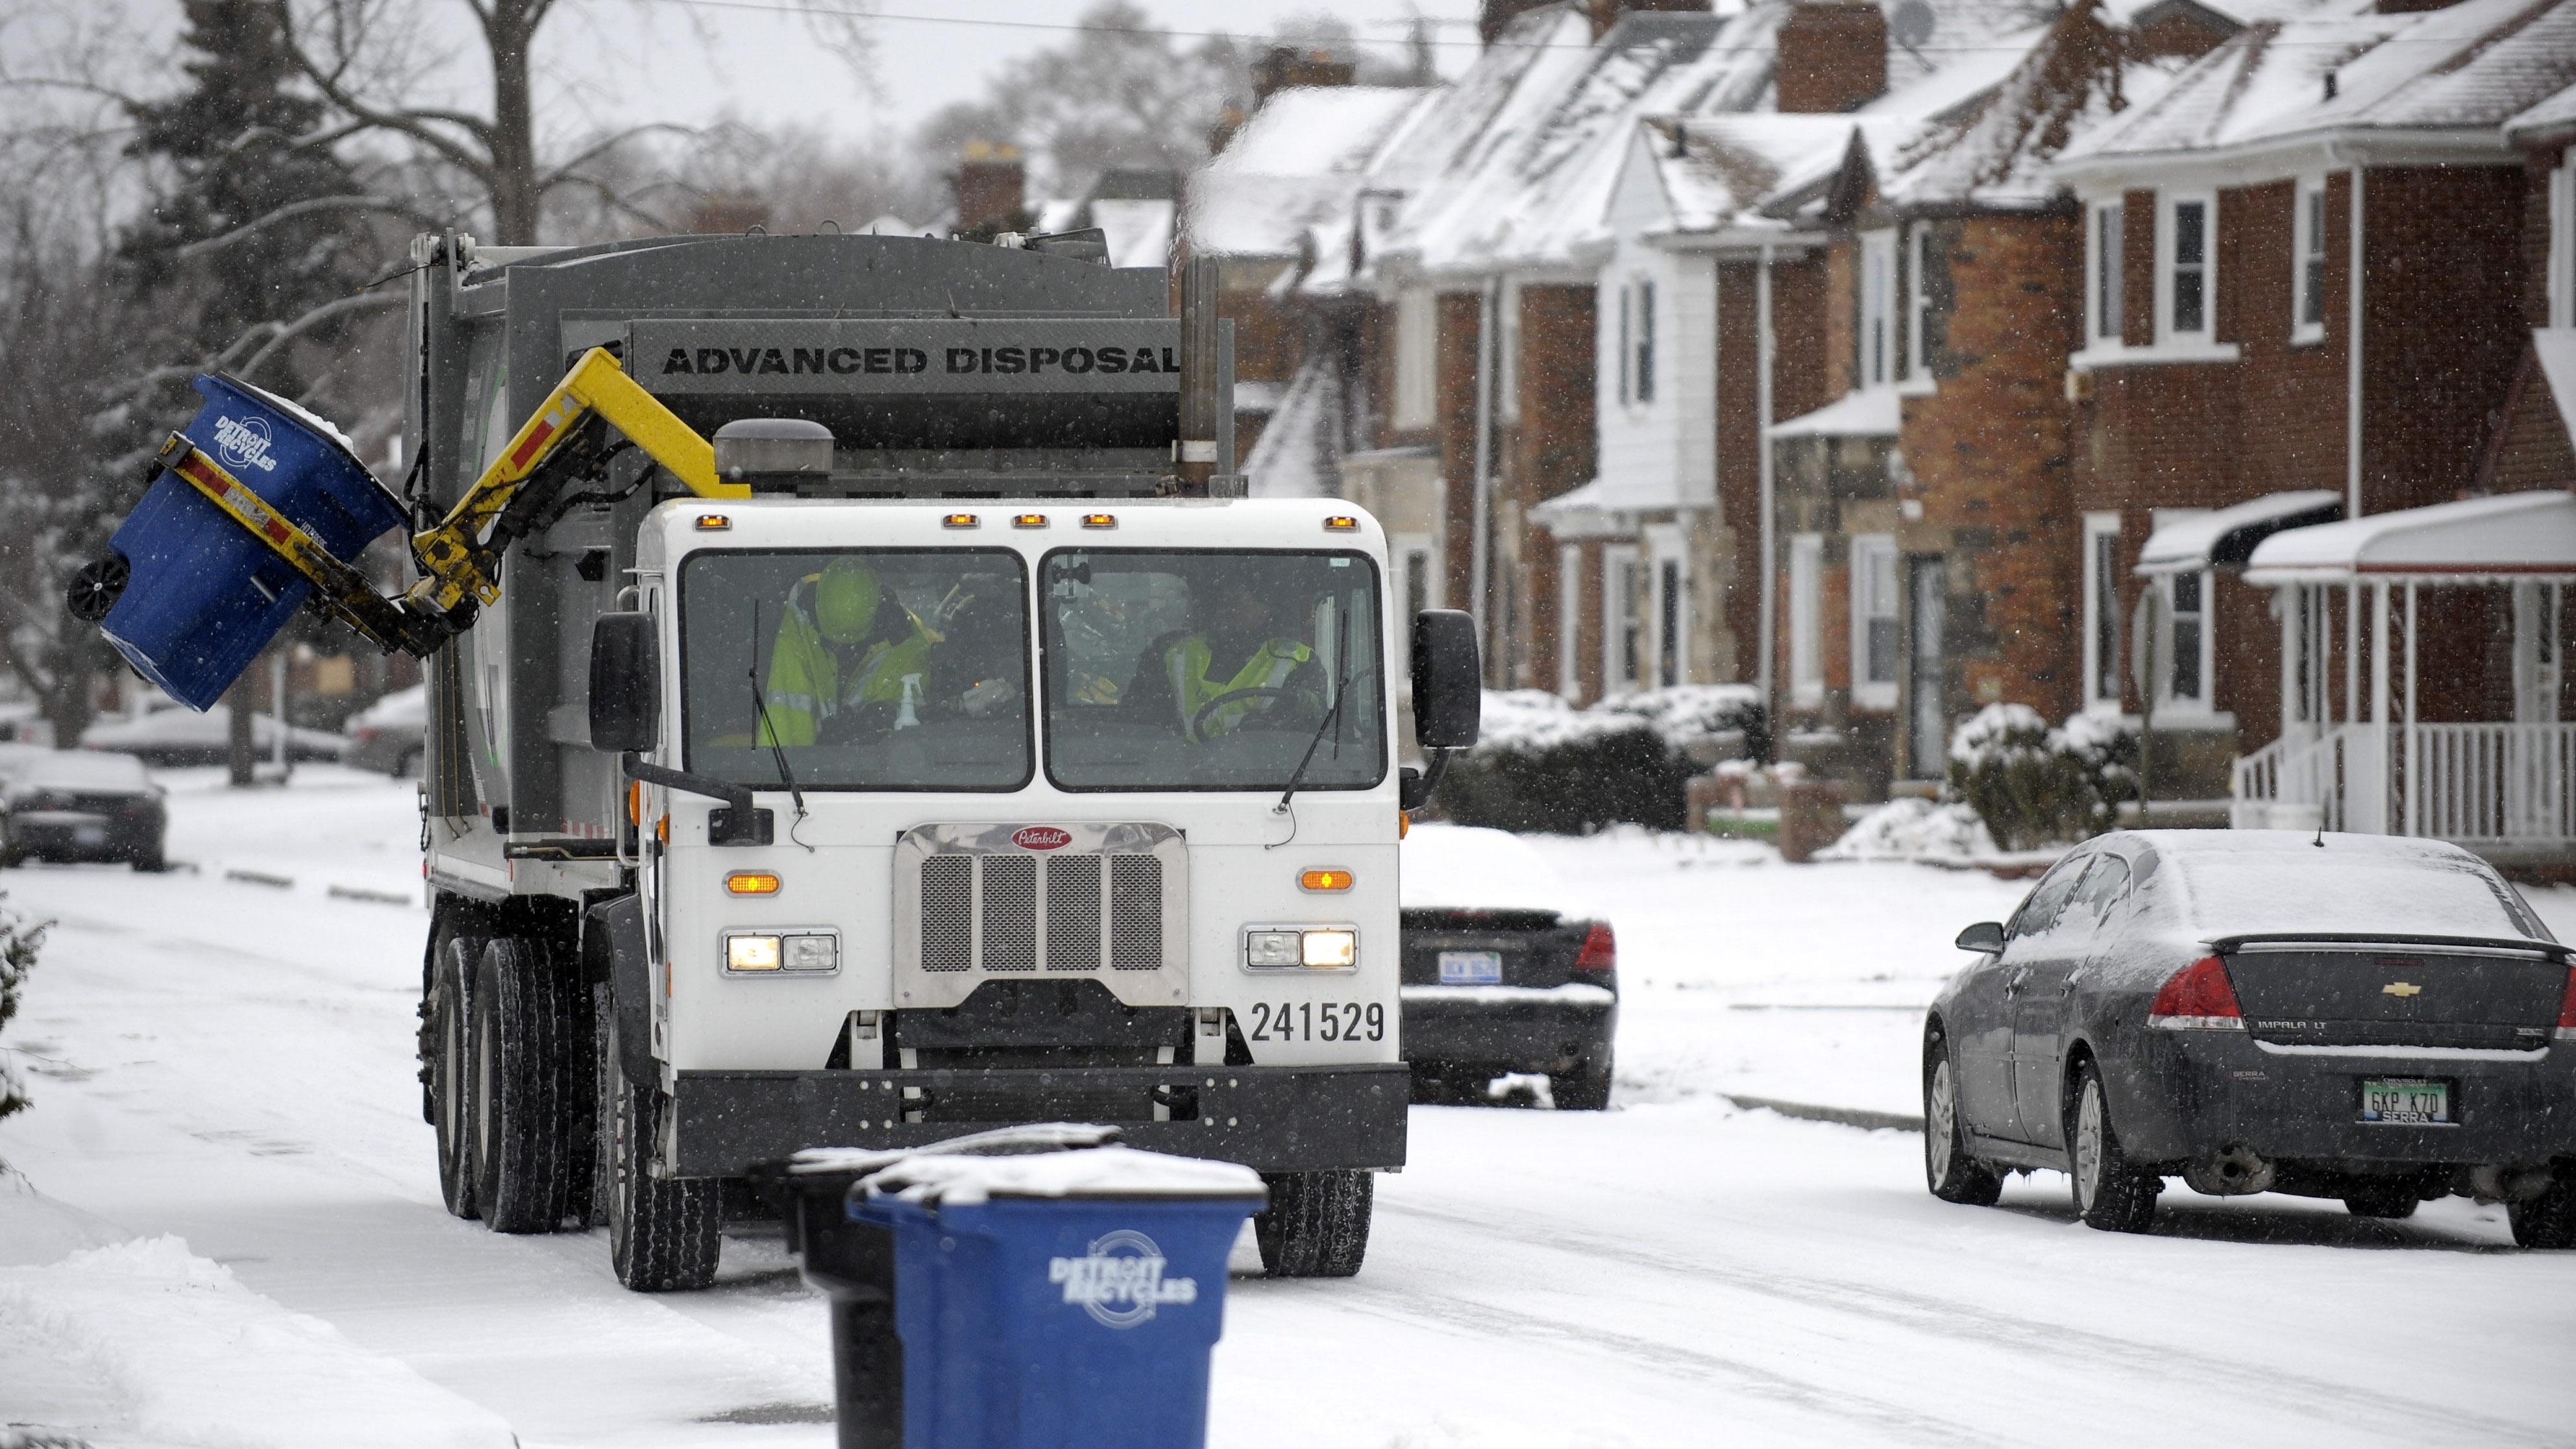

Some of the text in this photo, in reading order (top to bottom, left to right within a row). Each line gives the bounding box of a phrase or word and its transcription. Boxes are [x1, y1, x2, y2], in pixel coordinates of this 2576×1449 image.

[662, 347, 1181, 374] ADVANCED DISPOSAL
[215, 415, 271, 453] DETROIT
[214, 429, 276, 471] RECYCLES
[1018, 830, 1067, 845] Peterbilt
[1251, 1002, 1384, 1041] 241529
[2259, 1021, 2307, 1029] IMPALA
[2372, 1091, 2399, 1112] 6KP
[2383, 1111, 2429, 1123] SERRA
[1049, 1256, 1167, 1284] DETROIT
[1062, 1277, 1198, 1304] RECYCLES
